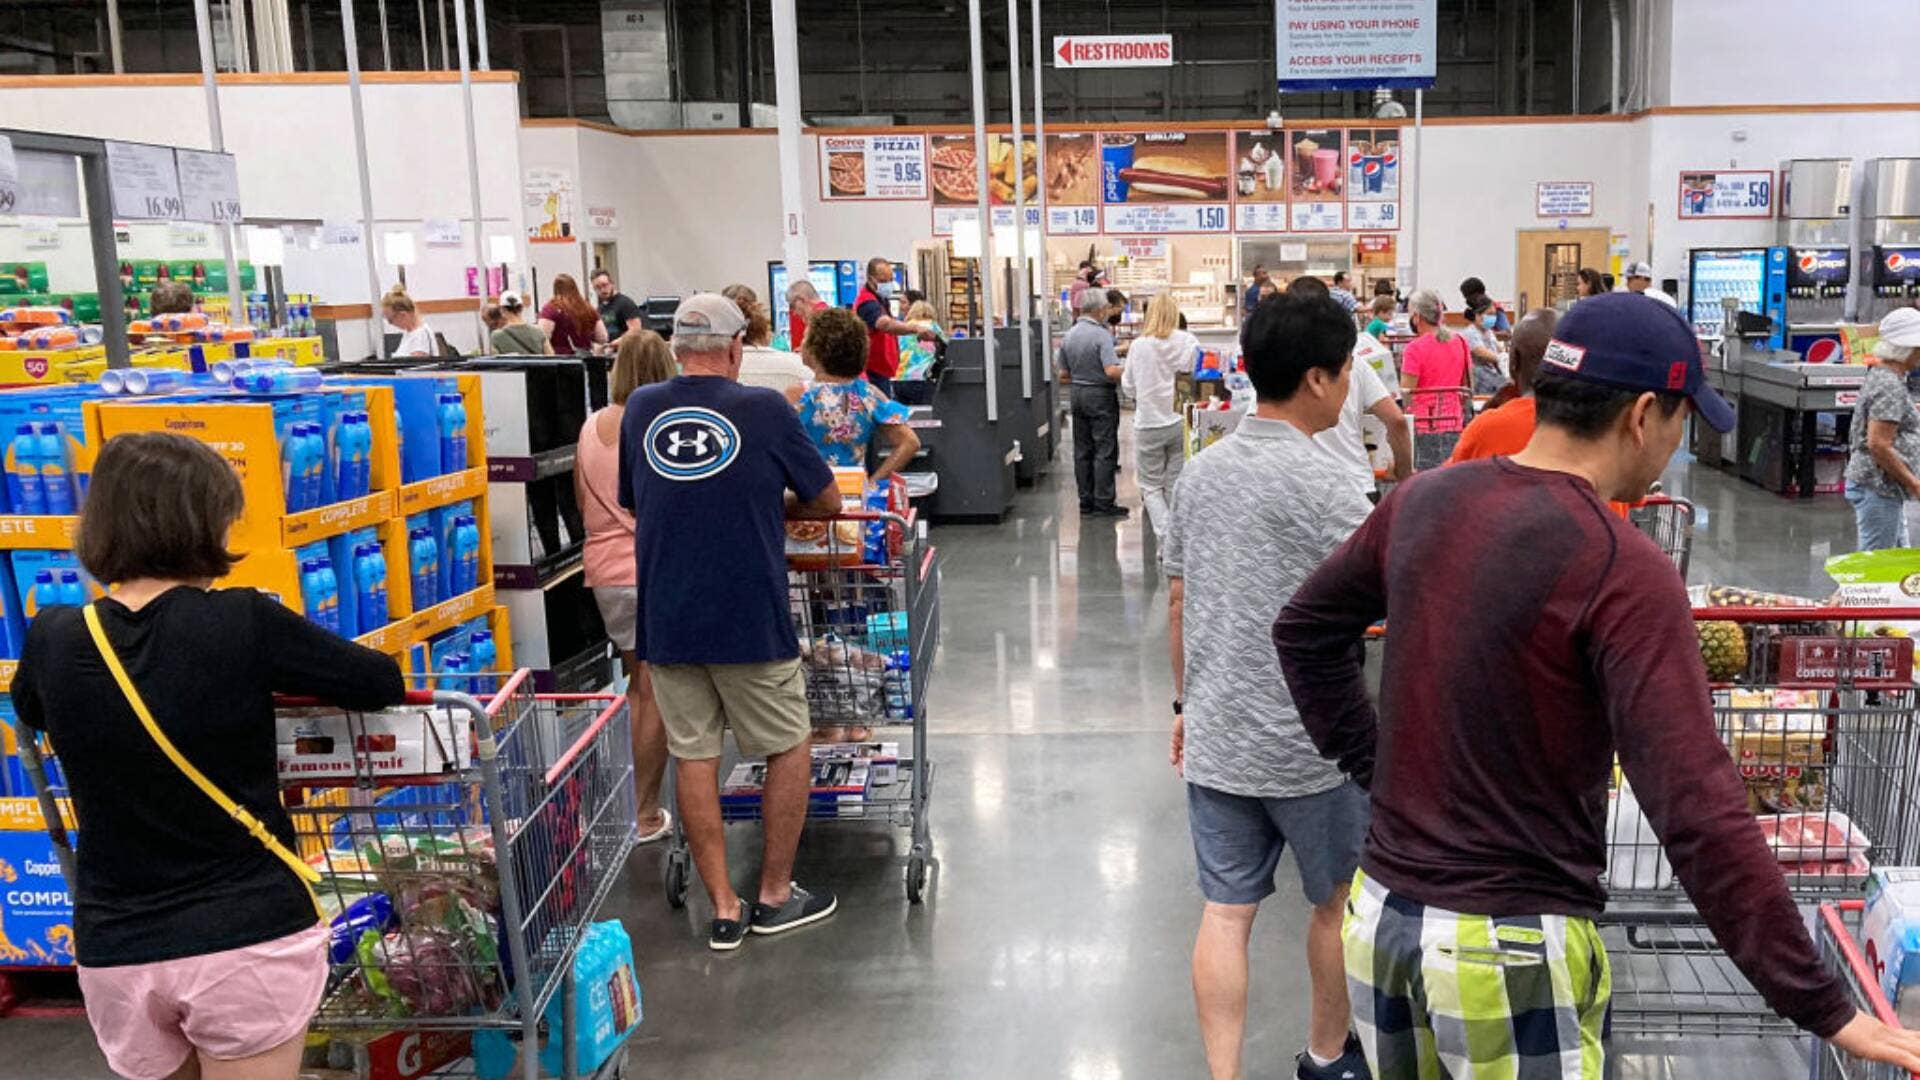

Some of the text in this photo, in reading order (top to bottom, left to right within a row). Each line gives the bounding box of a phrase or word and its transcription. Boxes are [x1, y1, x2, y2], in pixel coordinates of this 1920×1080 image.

[1289, 18, 1420, 30] PAY USING YOUR PHONE
[1074, 42, 1170, 61] RESTROOMS
[1289, 54, 1422, 66] ACCESS YOUR RECEIPTS
[826, 138, 865, 146] Costco
[1145, 133, 1186, 141] KIRKLAND
[873, 142, 920, 151] PIZZA!
[894, 162, 922, 182] 9.95
[1104, 161, 1120, 202] pepsi
[1744, 181, 1769, 207] .59
[145, 197, 180, 217] 16.99
[211, 200, 241, 220] 13.99
[1378, 203, 1394, 221] .59
[1073, 209, 1096, 226] 1.49
[1197, 207, 1225, 229] 1.50
[1818, 258, 1846, 269] pepsi
[427, 473, 465, 496] COMPLETE
[320, 500, 368, 525] COMPLETE
[1845, 586, 1881, 594] Cooked
[1845, 596, 1890, 606] Wontons
[1796, 668, 1835, 678] COSTCO
[279, 757, 404, 773] Famous Fruit
[1741, 764, 1802, 777] UDON
[7, 890, 74, 907] COMPL
[397, 1033, 423, 1077] G
